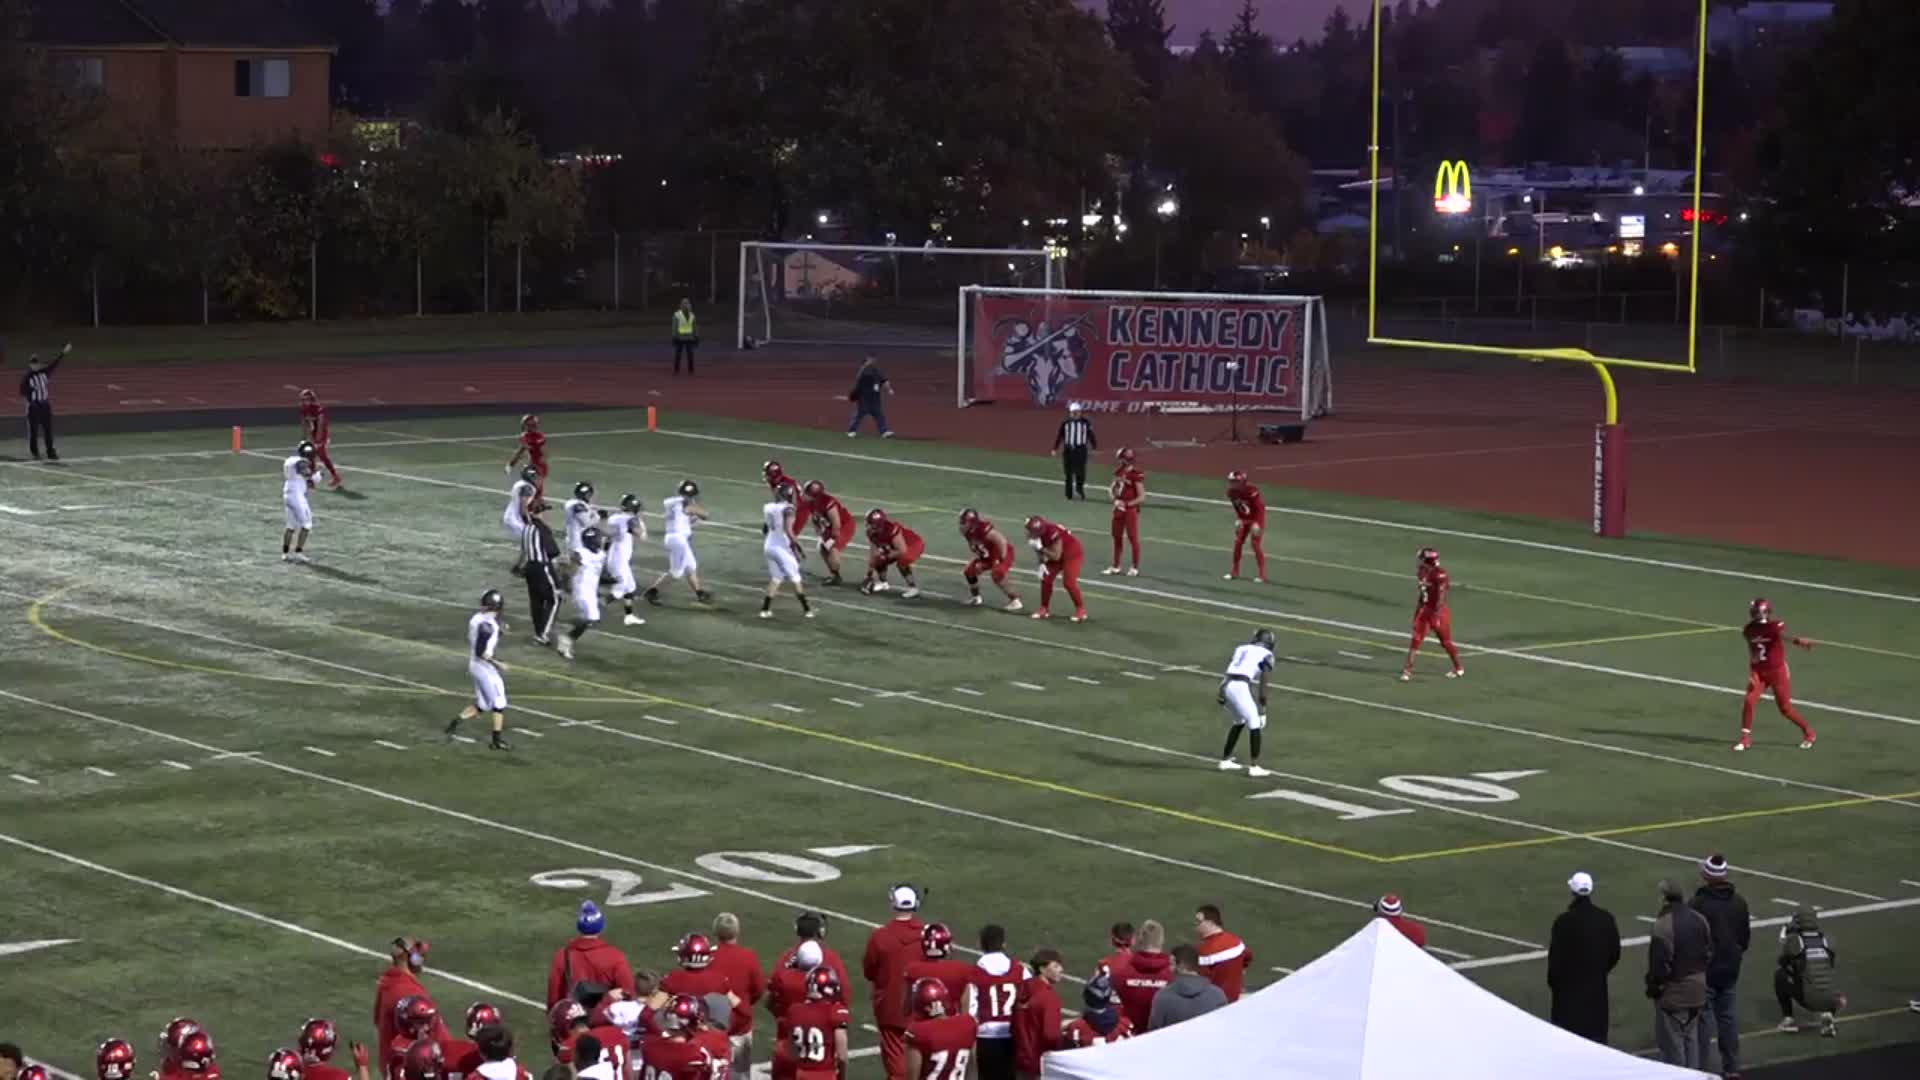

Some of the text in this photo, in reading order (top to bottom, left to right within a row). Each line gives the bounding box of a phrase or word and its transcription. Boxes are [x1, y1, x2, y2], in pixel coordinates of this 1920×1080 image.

[1107, 305, 1293, 350] KENNEDY
[1108, 350, 1289, 395] CATHOLIC
[528, 851, 842, 906] 20
[989, 983, 1016, 1017] 17
